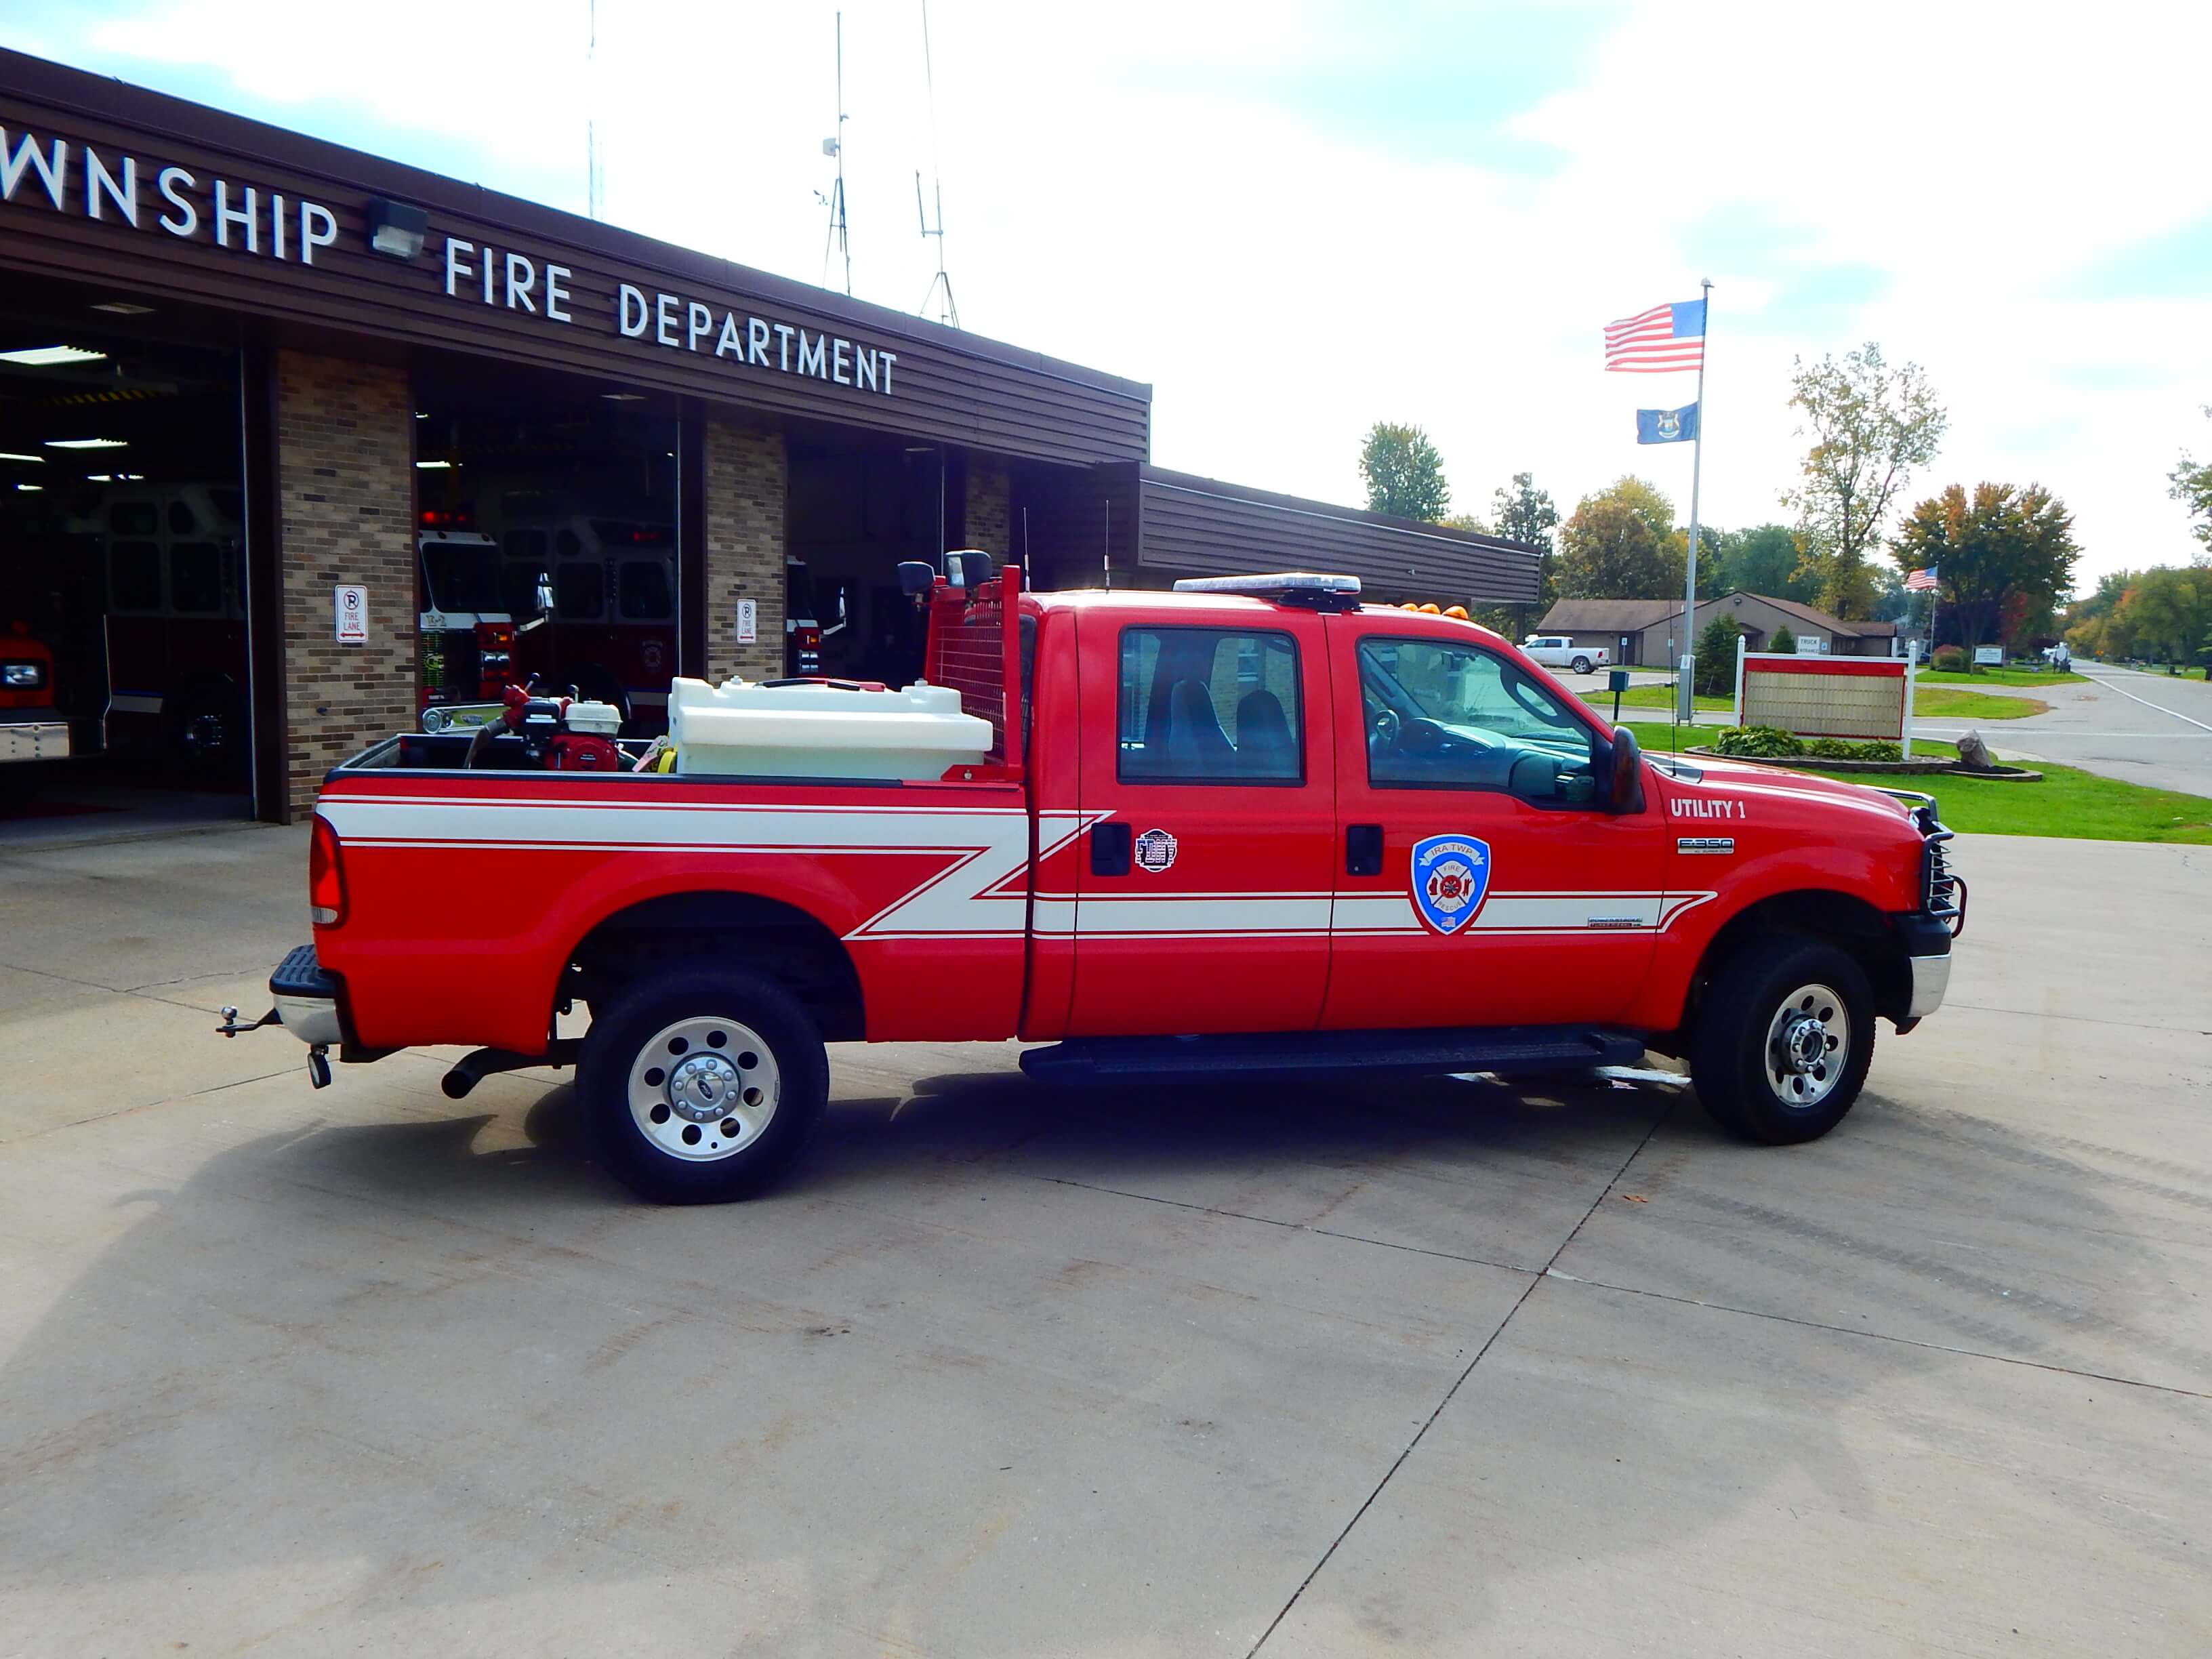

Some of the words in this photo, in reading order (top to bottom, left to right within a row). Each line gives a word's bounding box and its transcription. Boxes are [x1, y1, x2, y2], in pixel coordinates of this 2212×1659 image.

[447, 237, 571, 323] FIRE
[619, 283, 897, 395] DEPARTMENT
[345, 613, 359, 621] FIRE
[344, 622, 361, 631] LANE
[1671, 798, 1733, 819] UTILITY
[1738, 800, 1746, 819] 1
[1431, 845, 1449, 857] IRA
[1437, 900, 1462, 911] RESCUE
